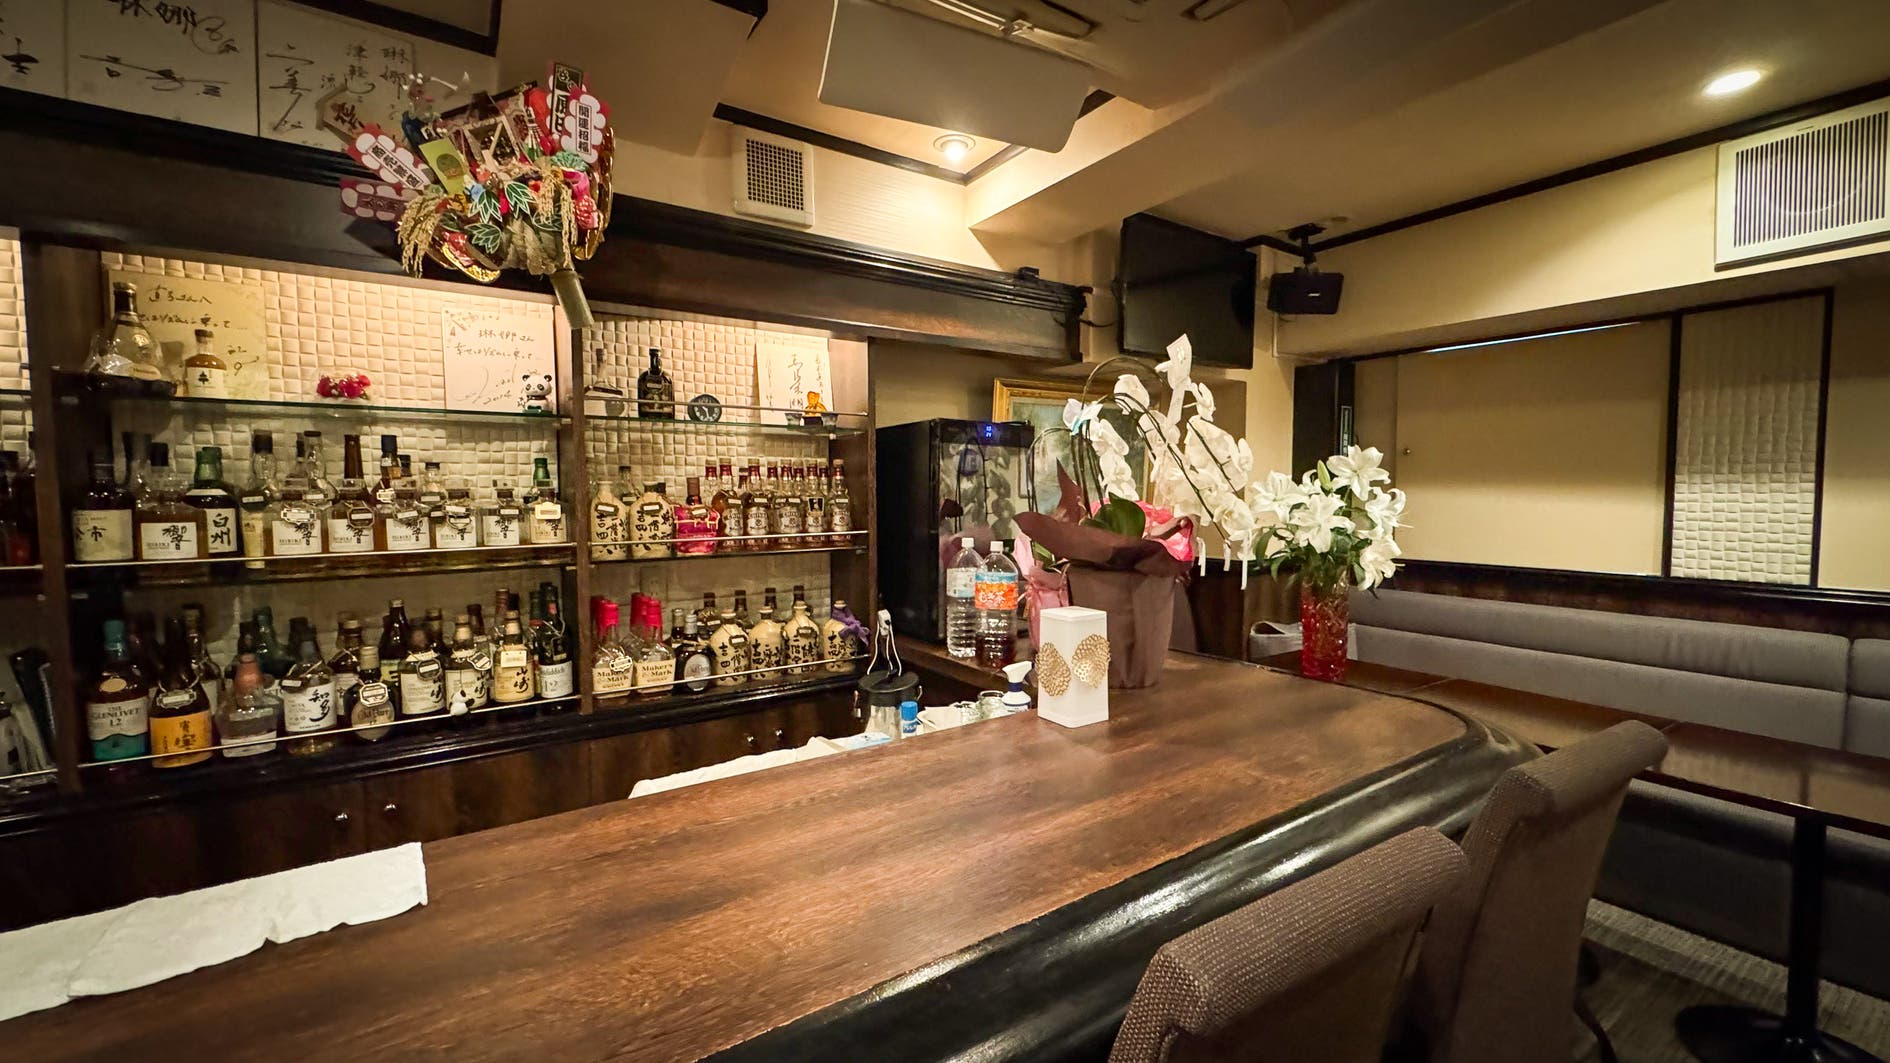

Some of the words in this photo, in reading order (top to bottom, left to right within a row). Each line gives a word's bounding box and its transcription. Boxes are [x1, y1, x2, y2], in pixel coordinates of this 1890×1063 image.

[162, 525, 191, 551] 響
[209, 513, 231, 546] 白州
[513, 667, 530, 694] 山崎
[94, 708, 139, 720] GLENLIVET
[308, 689, 331, 723] 知多
[109, 719, 121, 727] 12
